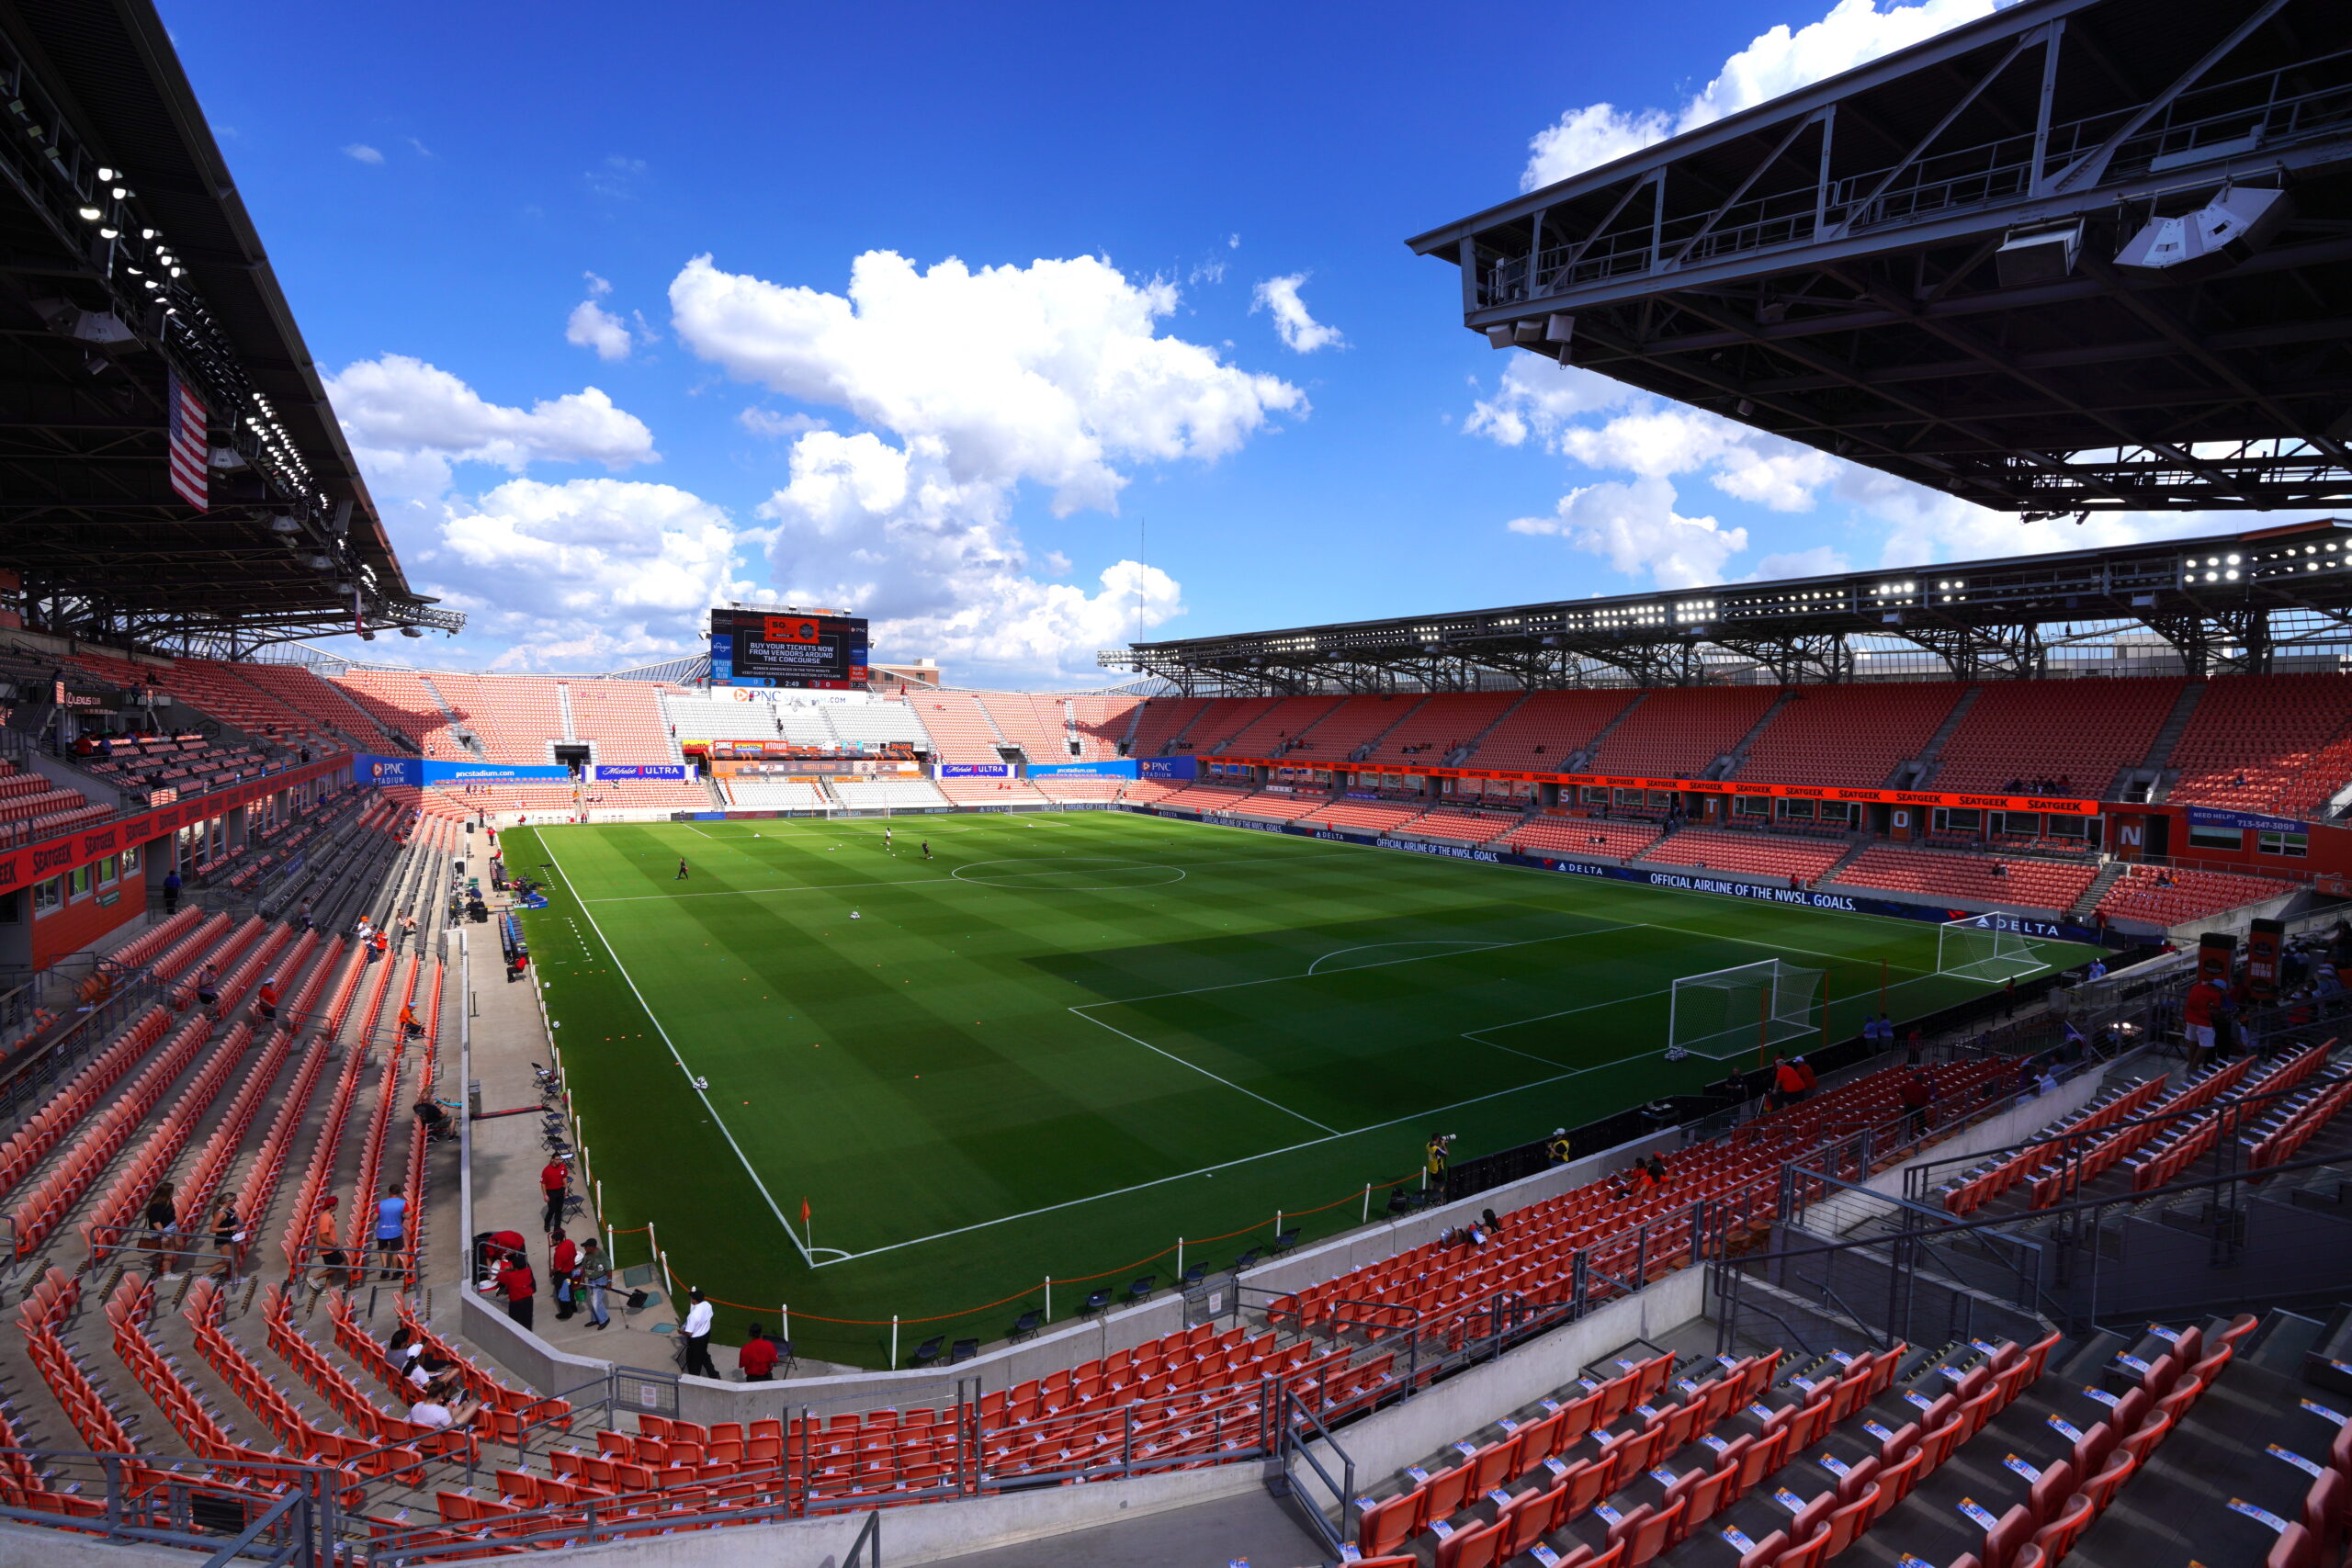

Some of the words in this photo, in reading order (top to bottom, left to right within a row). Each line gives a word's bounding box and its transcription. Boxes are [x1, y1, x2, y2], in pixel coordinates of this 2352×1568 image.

[786, 644, 816, 652] TICKETS
[778, 656, 821, 664] CONCOURSE
[74, 696, 92, 705] LEXUS
[752, 691, 781, 702] PNC
[715, 741, 734, 750] SURGE
[764, 742, 787, 750] HTOWN
[384, 763, 404, 774] PNC
[602, 767, 637, 775] Michelob
[1151, 762, 1171, 772] PNC
[456, 770, 514, 778] pncstadium.com
[1269, 770, 1274, 780] H
[373, 776, 404, 784] STADIUM
[1442, 781, 1451, 793] U
[1499, 772, 1523, 780] SEATGEEK
[1532, 773, 1559, 782] SEATGEEK
[1568, 776, 1596, 784] SEATGEEK
[1606, 778, 1635, 786] SEATGEEK
[1646, 780, 1678, 789] SEATGEEK
[1690, 782, 1724, 791] SEATGEEK
[1735, 784, 1771, 794] SEATGEEK
[1785, 787, 1824, 796] SEATGEEK
[1838, 790, 1880, 800] SEATGEEK
[1896, 793, 1941, 804] SEATGEEK
[1959, 796, 2008, 807] SEATGEEK
[2028, 800, 2082, 812] SEATGEEK
[1559, 789, 1569, 803] S
[1706, 798, 1718, 814] T
[1894, 810, 1909, 828] O
[2212, 813, 2235, 821] HELP?
[1203, 816, 1219, 824] OFFICIAL
[1220, 818, 1236, 826] AIRLINE
[1243, 820, 1251, 829] THE
[1266, 823, 1283, 832] GOALS.
[2120, 826, 2141, 845] N
[33, 840, 73, 875] SEATGEEK
[85, 829, 117, 858] SEATGEEK
[1376, 838, 1403, 850] OFFICIAL
[1403, 841, 1428, 852] AIRLINE
[1428, 844, 1437, 853] OF
[1438, 846, 1451, 856] THE
[1452, 849, 1473, 859] NWSL.
[1474, 851, 1498, 863] GOALS.
[1569, 863, 1603, 875] DELTA
[1650, 873, 1691, 890] OFFICIAL
[1693, 878, 1733, 896] AIRLINE
[1735, 884, 1749, 897] OF
[1751, 886, 1772, 900] THE
[1775, 889, 1810, 905] NWSL.
[1814, 894, 1856, 911] GOALS.
[1997, 919, 2059, 936] DELTA
